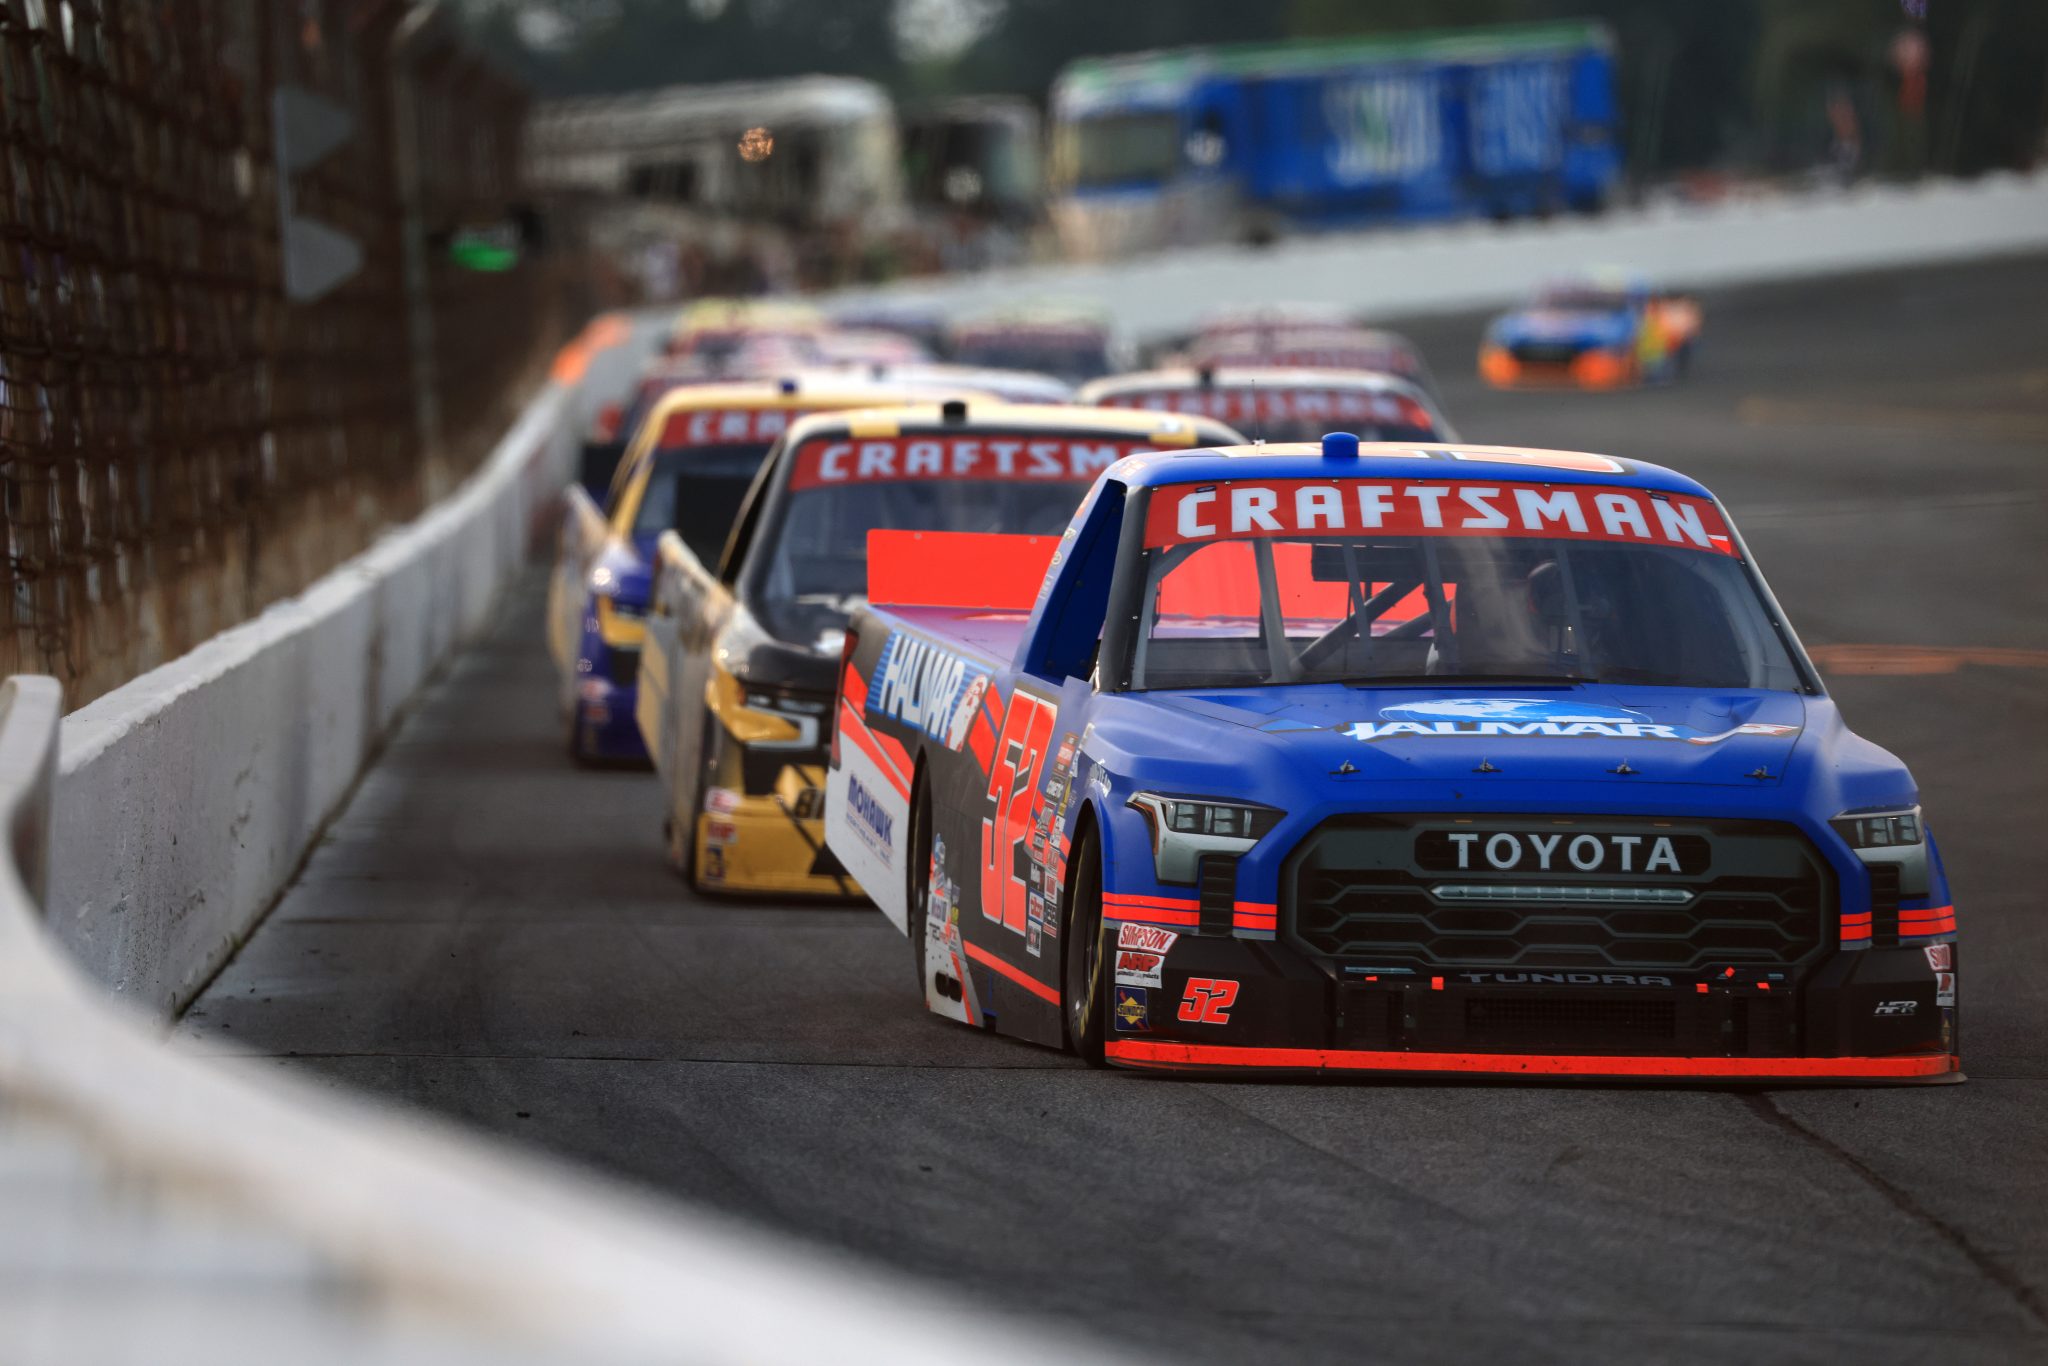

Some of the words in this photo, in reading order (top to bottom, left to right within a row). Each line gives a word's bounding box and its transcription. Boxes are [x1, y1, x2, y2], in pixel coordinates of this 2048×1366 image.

[819, 443, 1124, 478] CRAFTSM
[1178, 485, 1713, 548] CRAFTSMAN
[878, 634, 965, 740] HALMAR
[847, 774, 893, 847] MOHAWK
[977, 688, 1058, 937] 52
[1448, 832, 1682, 873] TOYOTA
[1120, 925, 1171, 950] SIMPSON
[1117, 952, 1160, 972] ARP
[1459, 972, 1673, 987] TUNDRA
[1117, 1003, 1146, 1018] SUNOCO
[1177, 977, 1240, 1025] 52
[1874, 1000, 1918, 1016] HFR
